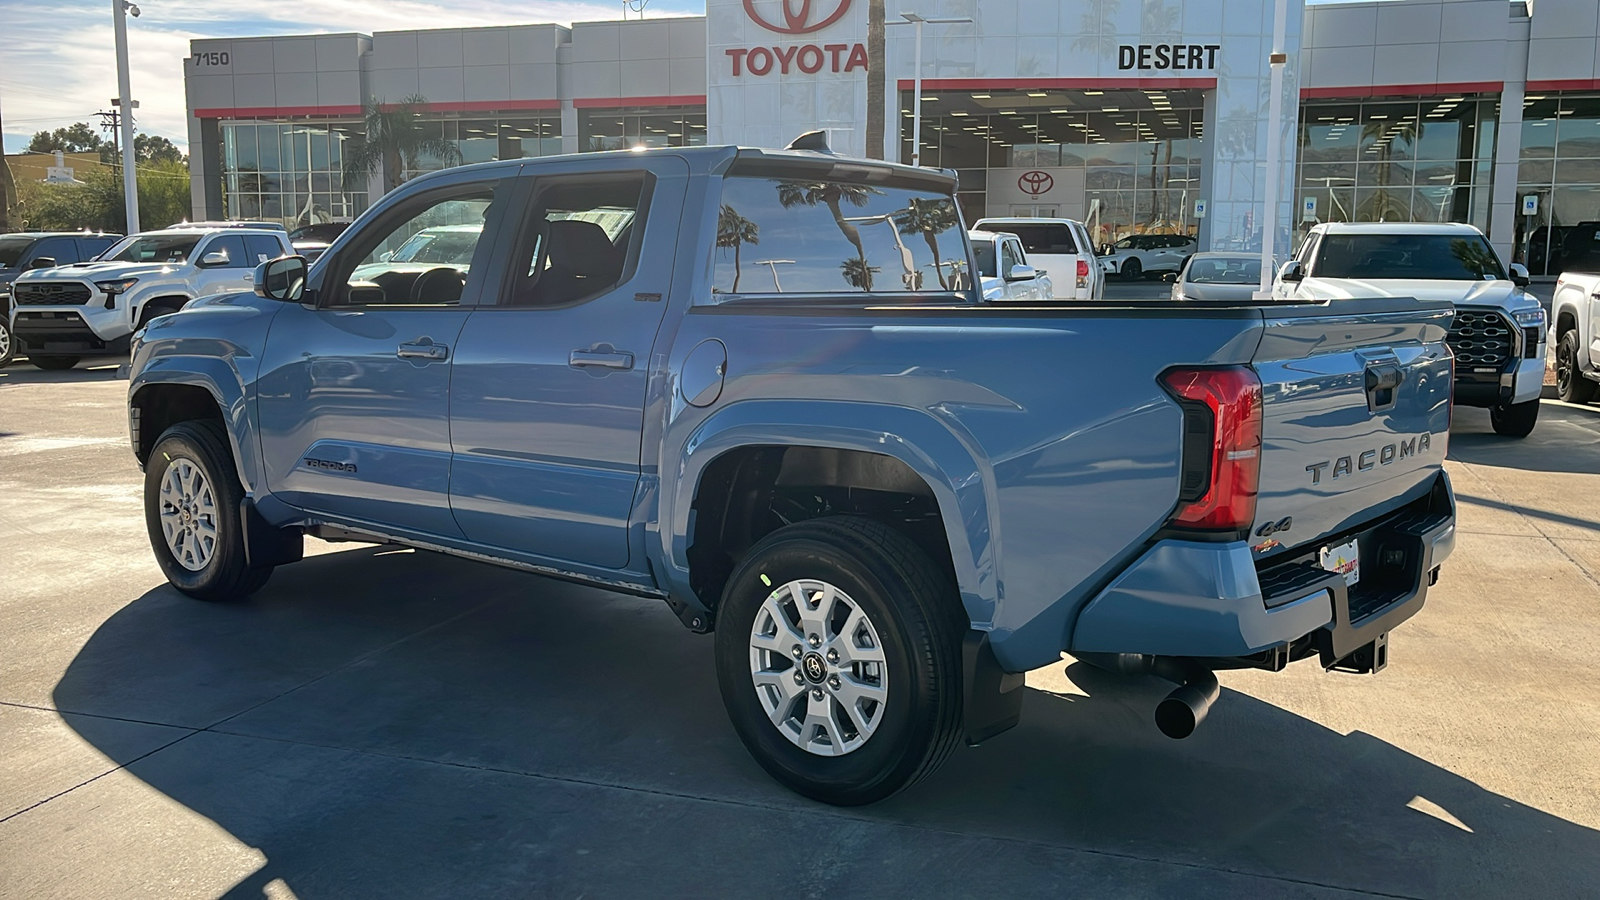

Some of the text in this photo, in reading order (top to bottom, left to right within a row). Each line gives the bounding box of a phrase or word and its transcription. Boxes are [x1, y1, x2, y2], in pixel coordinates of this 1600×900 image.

[193, 52, 230, 67] 7150
[725, 43, 869, 77] TOYOTA
[1118, 44, 1221, 70] DESERT
[1305, 432, 1432, 486] TACOMA
